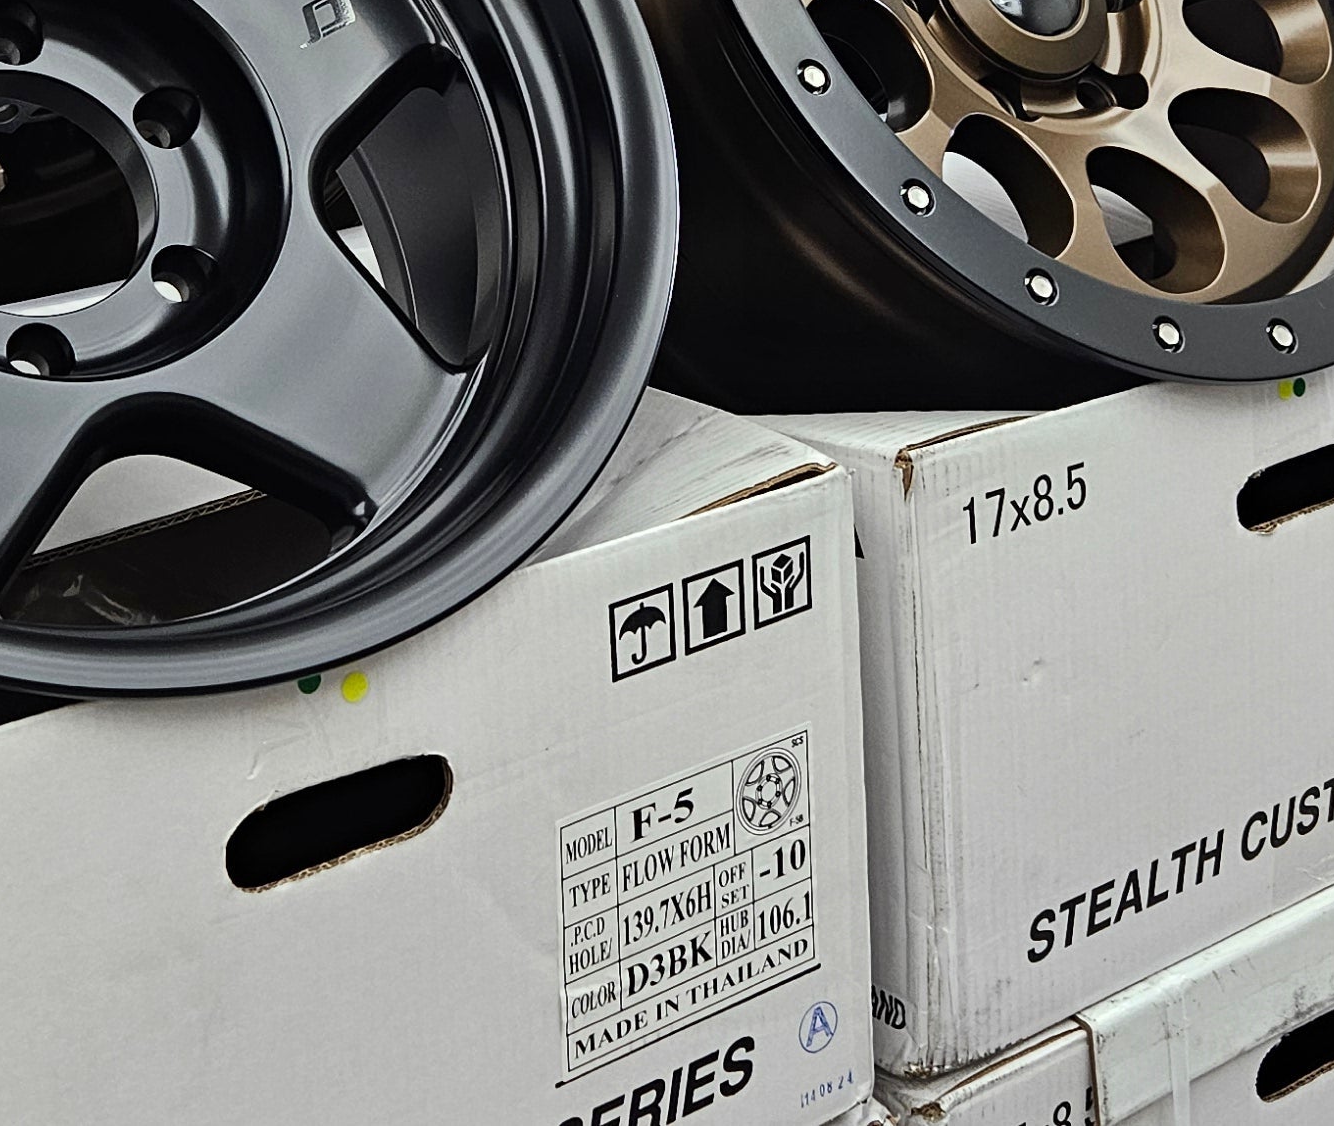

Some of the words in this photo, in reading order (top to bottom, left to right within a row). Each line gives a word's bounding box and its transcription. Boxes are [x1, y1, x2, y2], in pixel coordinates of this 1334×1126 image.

[962, 462, 1088, 547] 17x8.5
[565, 826, 613, 865] MODEL
[631, 787, 694, 843] F-5
[568, 872, 611, 908] TYPE
[621, 846, 676, 892] FLOW
[679, 821, 732, 869] FORM
[718, 861, 747, 888] OFF
[758, 838, 807, 881] -10
[622, 884, 713, 947] 139.7X6H
[719, 902, 750, 936] HUB
[756, 890, 813, 941] 106.1
[720, 884, 750, 909] SET
[1028, 829, 1226, 964] STEALTH
[568, 938, 613, 976] HOLE/
[571, 981, 617, 1020] COLOR
[625, 930, 713, 998] D3BK
[720, 929, 752, 961] DIA/
[573, 1009, 649, 1059] MADE
[655, 992, 680, 1022] IN
[685, 937, 809, 1006] THAILAND
[806, 1005, 835, 1048] A
